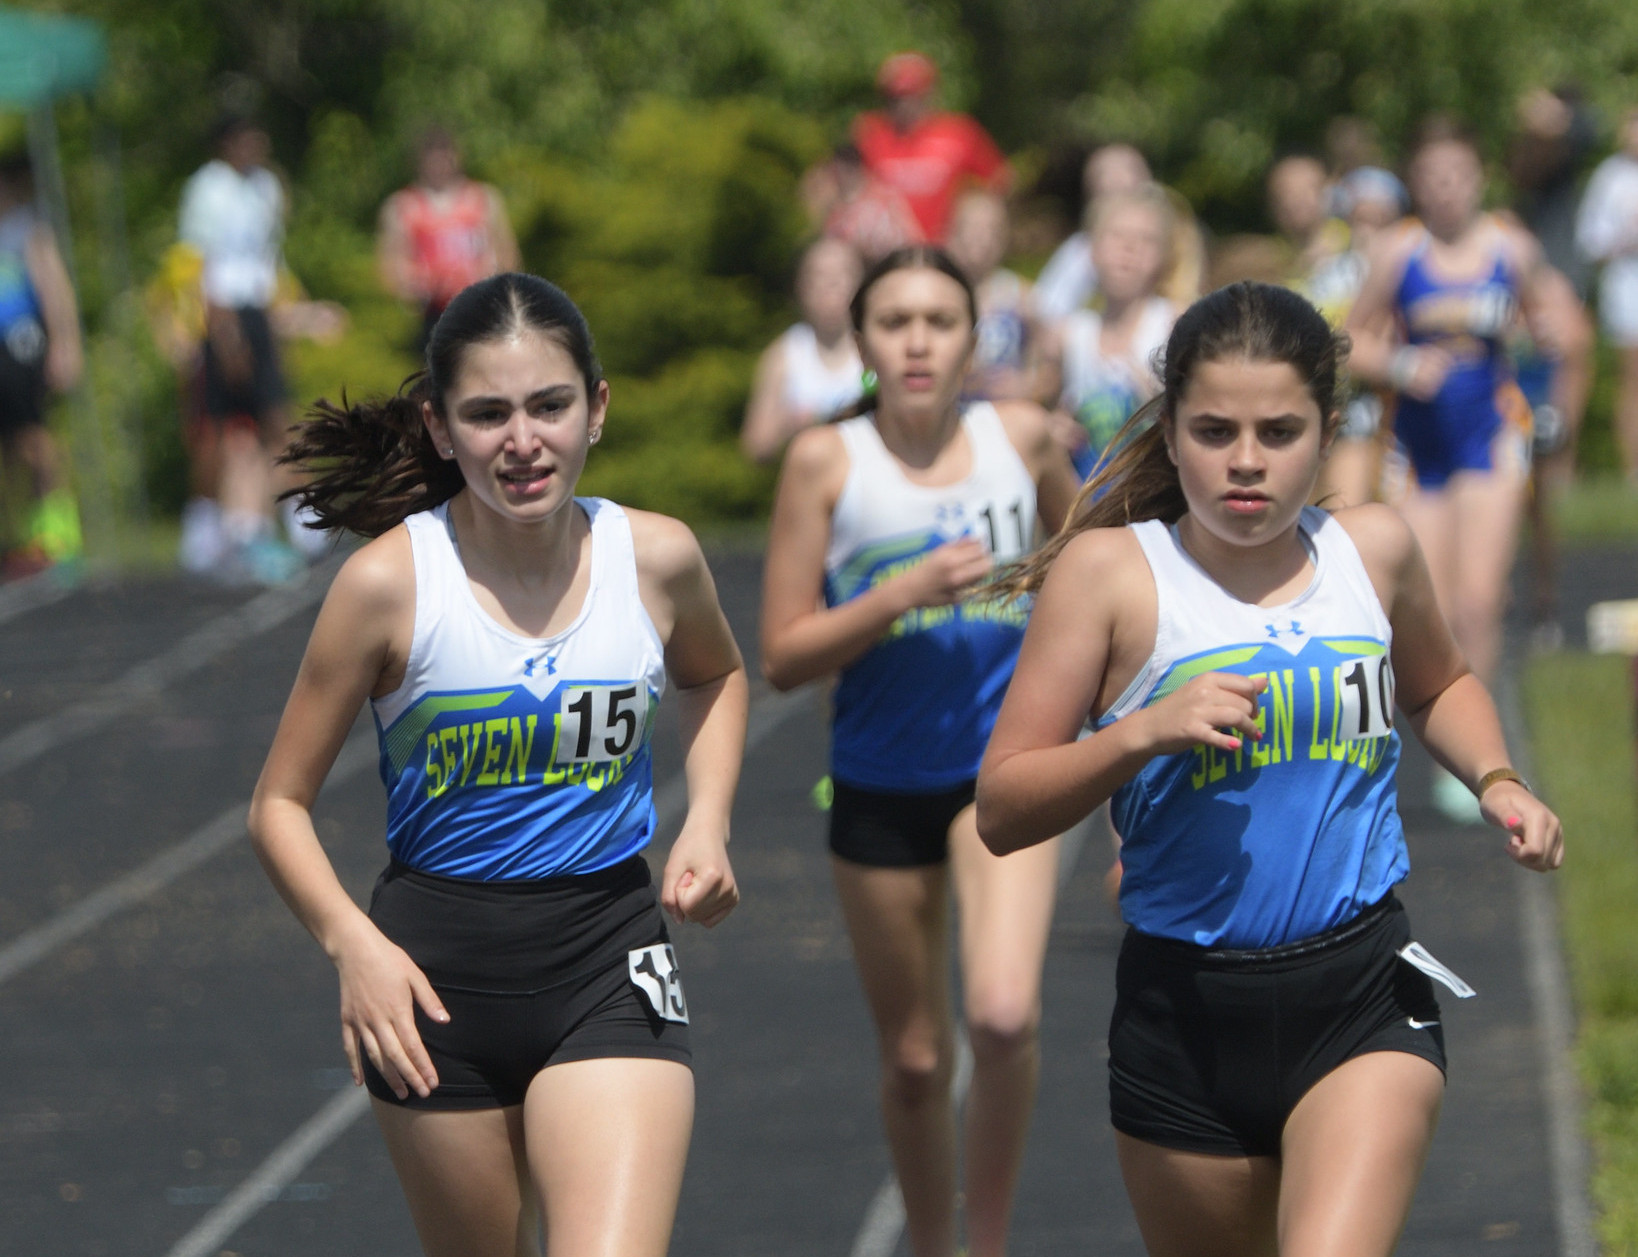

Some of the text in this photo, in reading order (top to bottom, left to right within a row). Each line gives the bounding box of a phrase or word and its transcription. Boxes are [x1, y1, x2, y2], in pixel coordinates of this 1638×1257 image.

[979, 499, 1026, 552] 11
[567, 686, 637, 758] 15
[1344, 655, 1393, 734] 10
[425, 714, 538, 798] SEVEN
